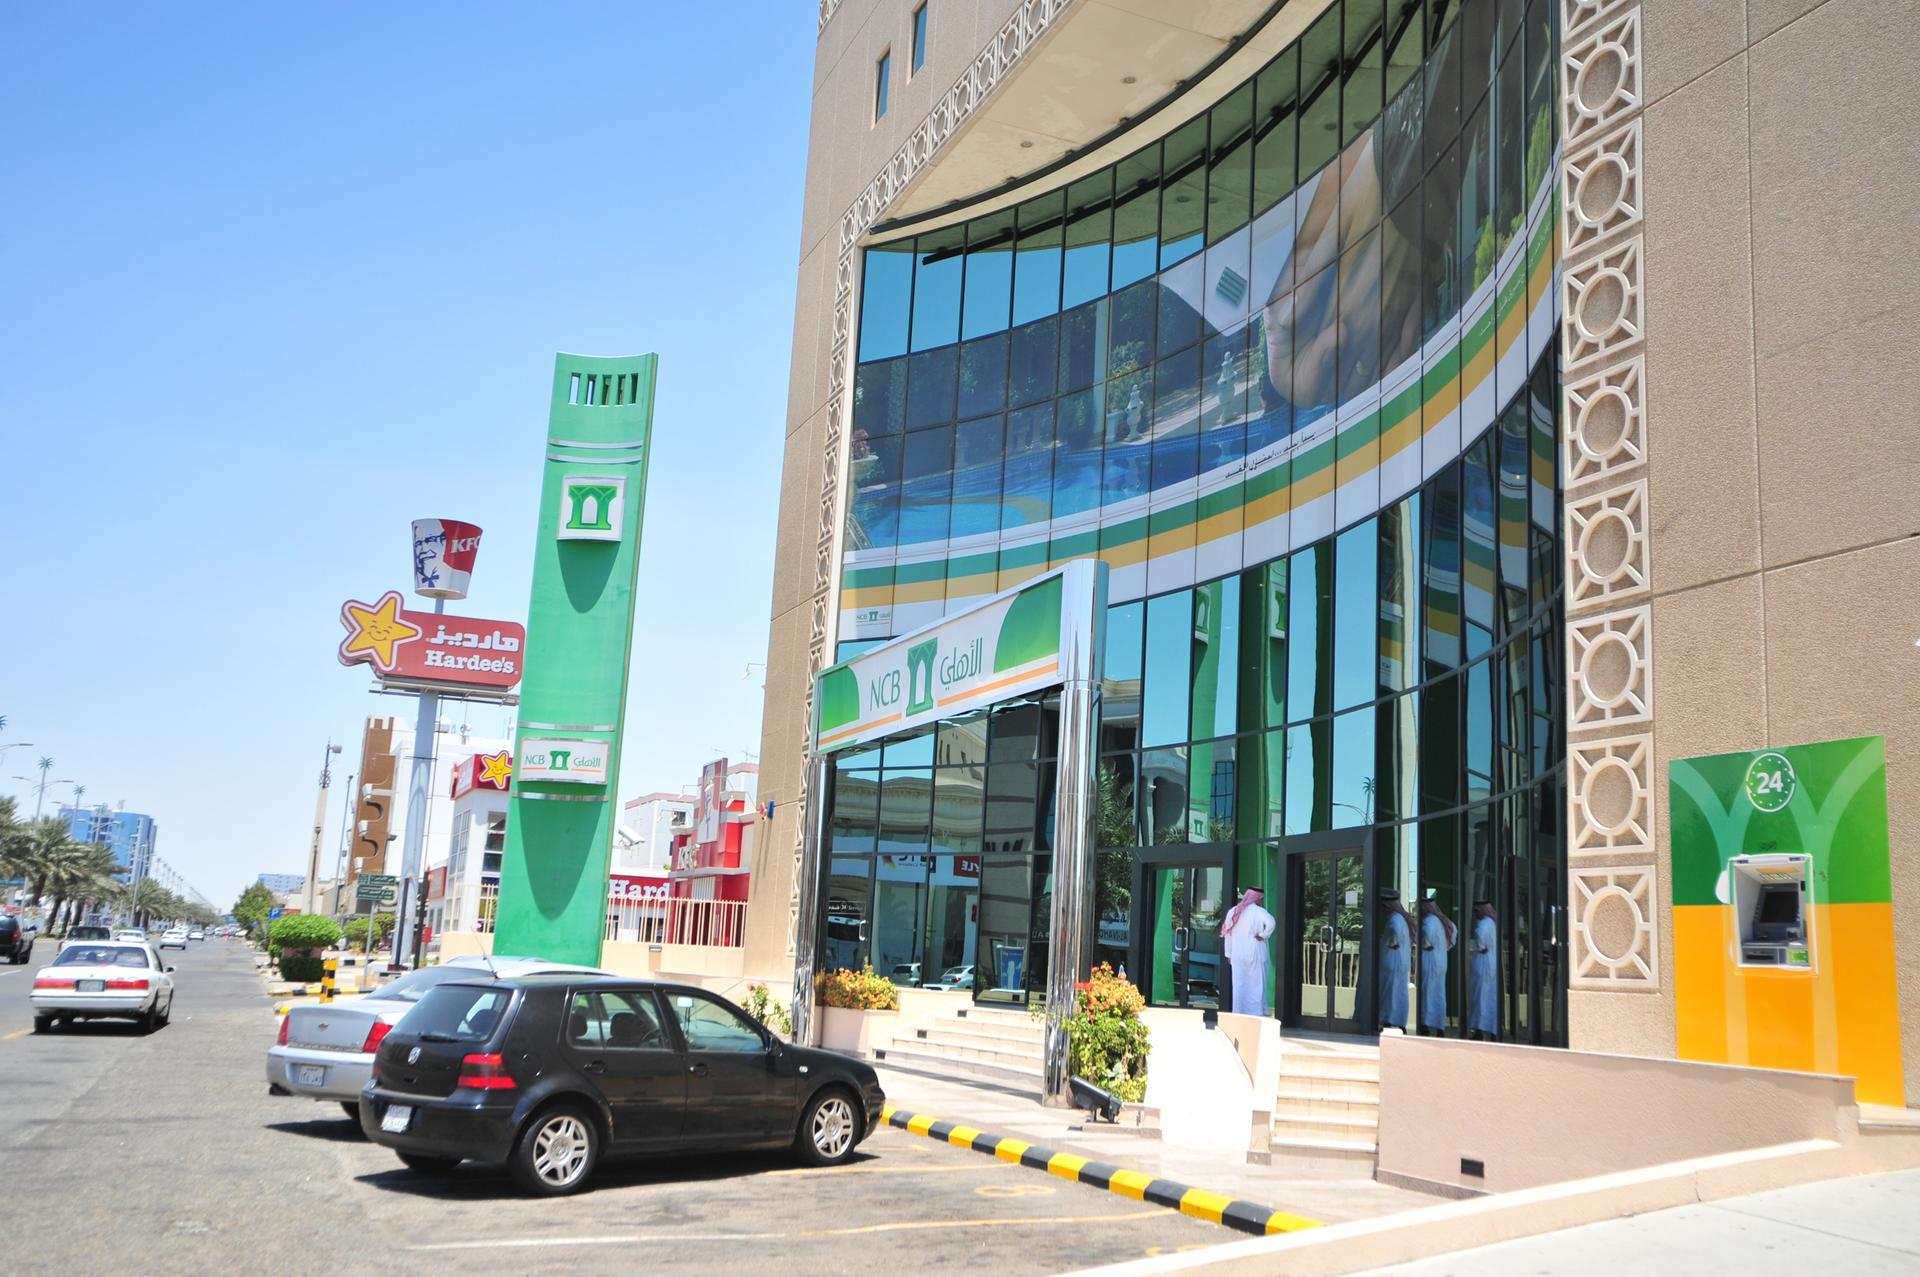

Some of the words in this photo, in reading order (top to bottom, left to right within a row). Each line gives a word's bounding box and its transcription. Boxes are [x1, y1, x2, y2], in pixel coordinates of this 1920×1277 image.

[430, 624, 520, 653] هارديز
[424, 649, 514, 674] Hardee's
[939, 636, 984, 692] الأهلي
[869, 669, 902, 712] NCB
[524, 754, 547, 765] NCB
[1756, 770, 1784, 794] 24
